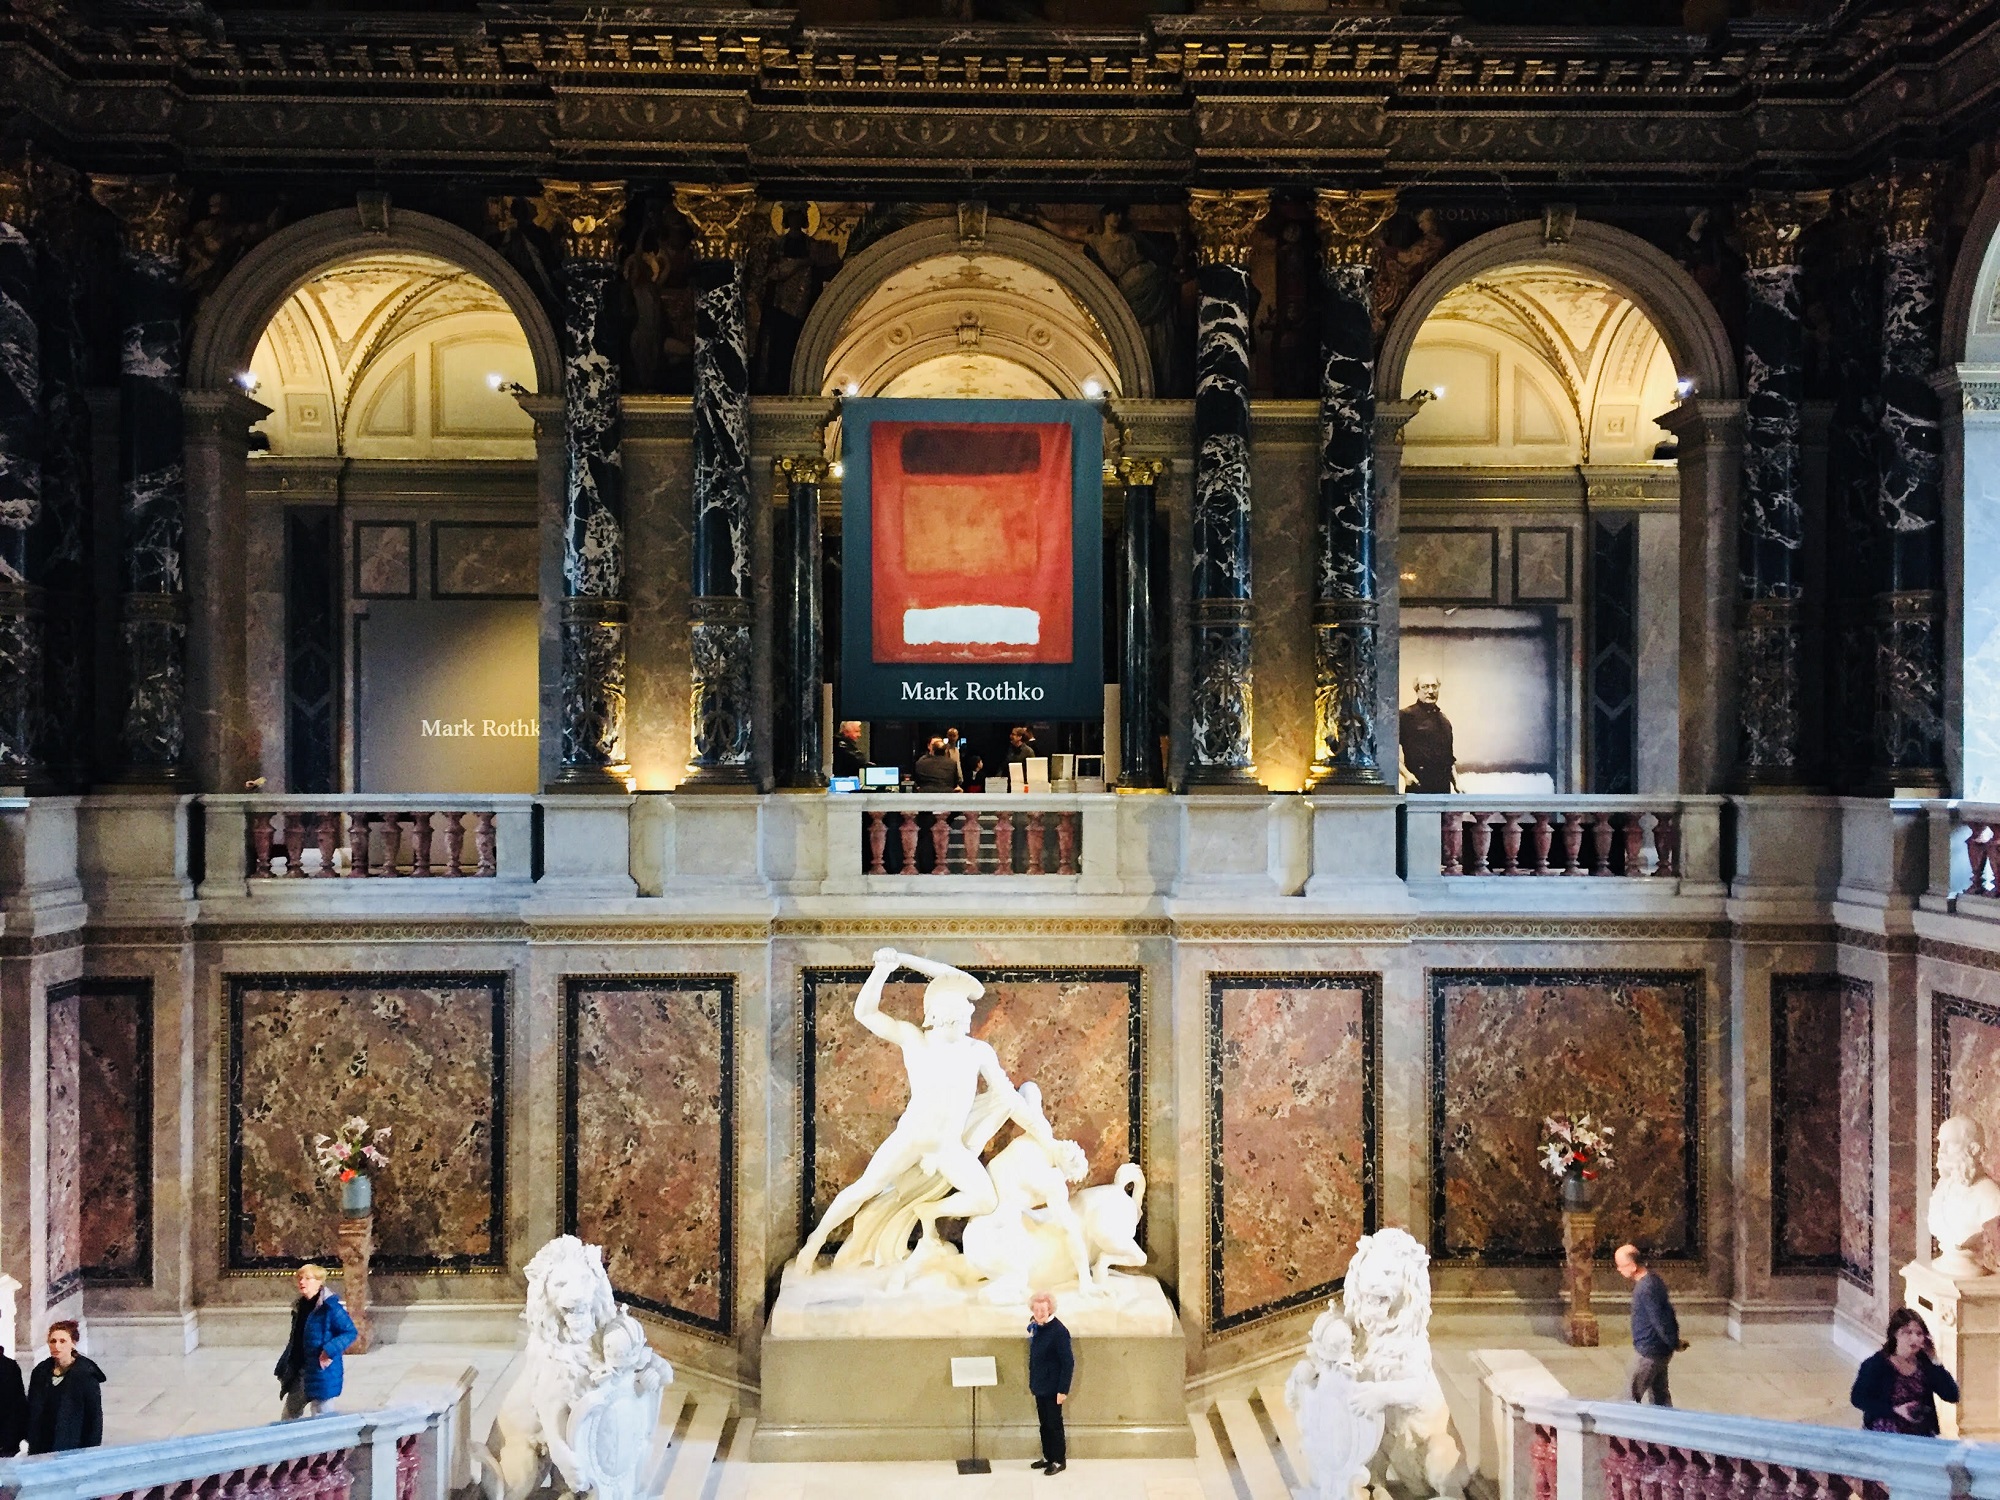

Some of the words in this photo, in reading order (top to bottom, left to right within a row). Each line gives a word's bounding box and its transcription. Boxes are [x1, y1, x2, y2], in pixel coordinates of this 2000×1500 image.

[901, 681, 958, 701] Mark
[966, 681, 1044, 701] Rothko
[420, 718, 475, 737] Mark
